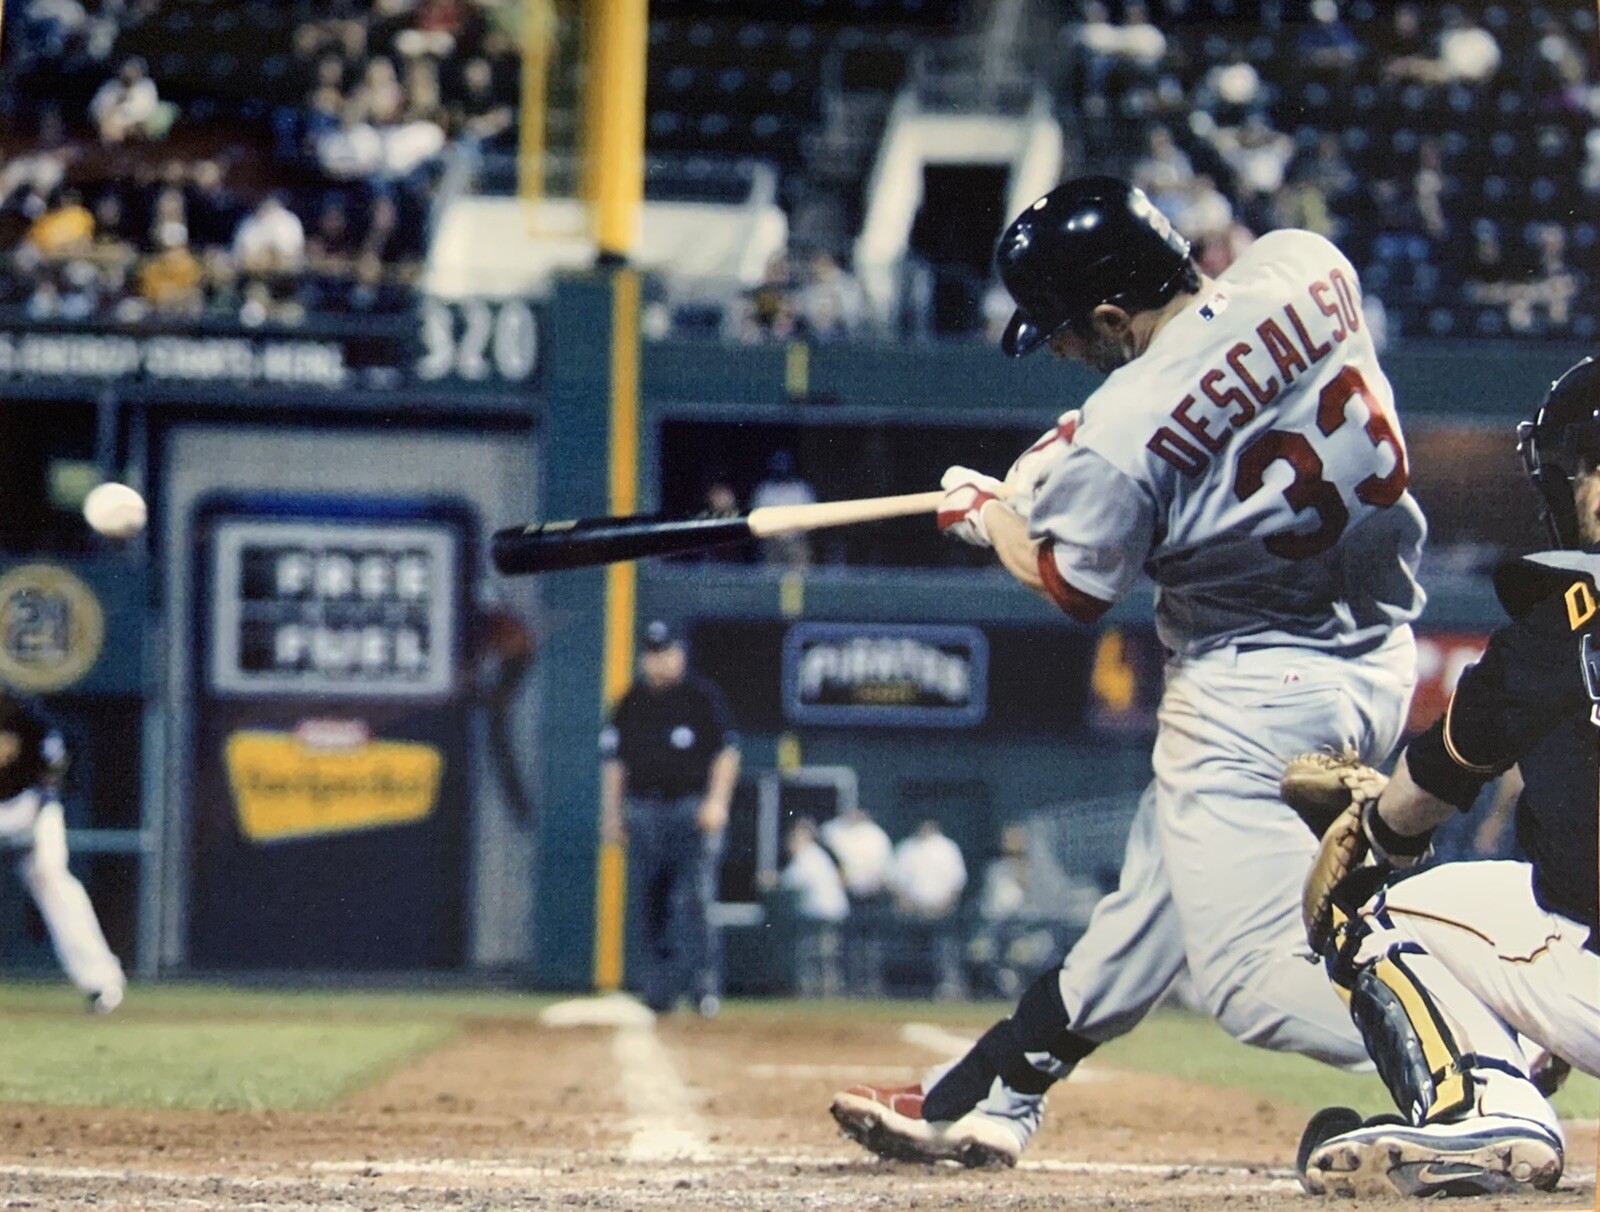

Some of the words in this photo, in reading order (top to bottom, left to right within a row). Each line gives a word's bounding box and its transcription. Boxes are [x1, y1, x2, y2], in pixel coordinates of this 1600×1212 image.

[417, 299, 538, 381] 320
[1146, 268, 1360, 478] DESCALSO
[1234, 364, 1409, 561] 33
[275, 554, 428, 599] FREE
[275, 624, 428, 669] FUEL
